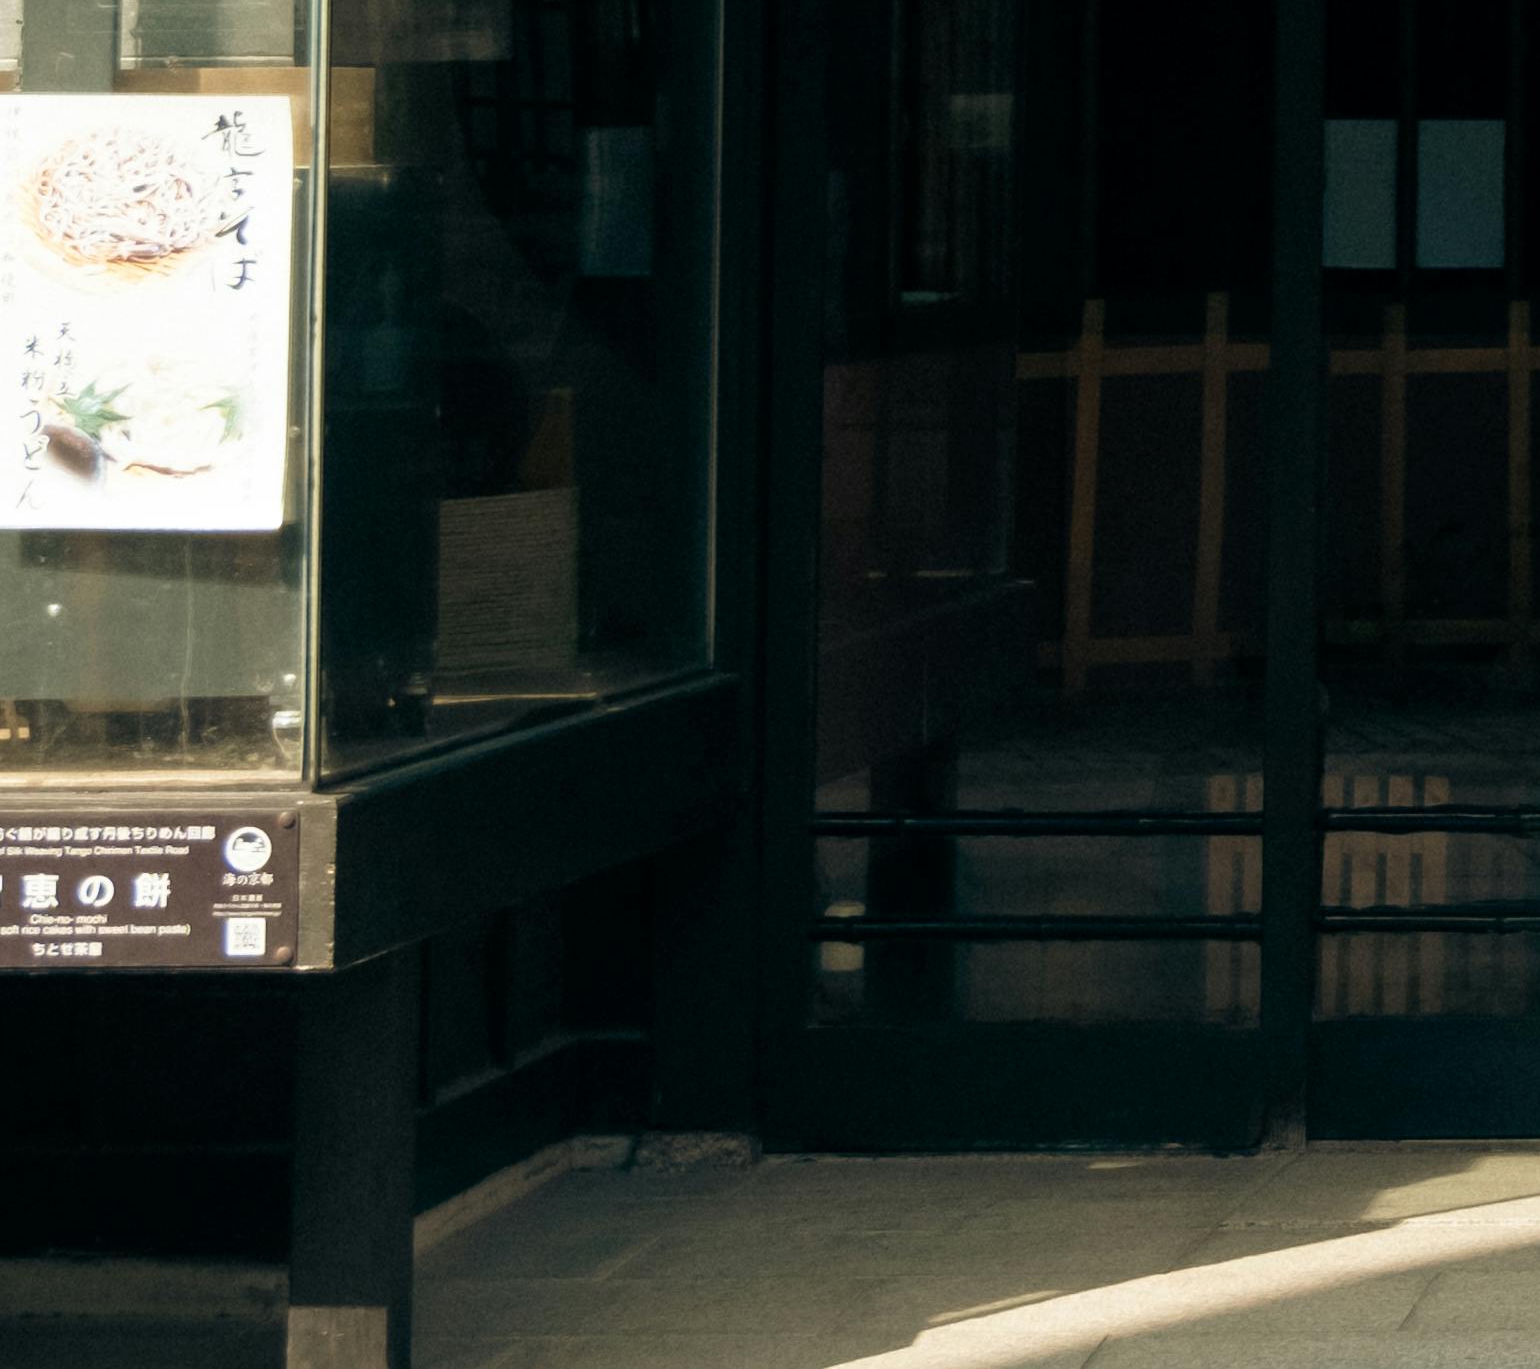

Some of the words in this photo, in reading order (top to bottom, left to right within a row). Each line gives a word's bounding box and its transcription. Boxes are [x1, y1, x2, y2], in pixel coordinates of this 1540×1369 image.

[201, 110, 266, 293] 龍宮そば
[165, 845, 190, 855] Road
[222, 873, 274, 887] 海の京都
[0, 872, 172, 909] 恵の餅
[76, 914, 108, 925] mochi
[21, 925, 41, 936] rice
[42, 925, 73, 936] cakes
[75, 925, 97, 936] with
[98, 925, 129, 936] sweet
[130, 925, 157, 936] bean
[158, 923, 192, 937] paste)
[31, 942, 103, 957] ちとせ茶屋
